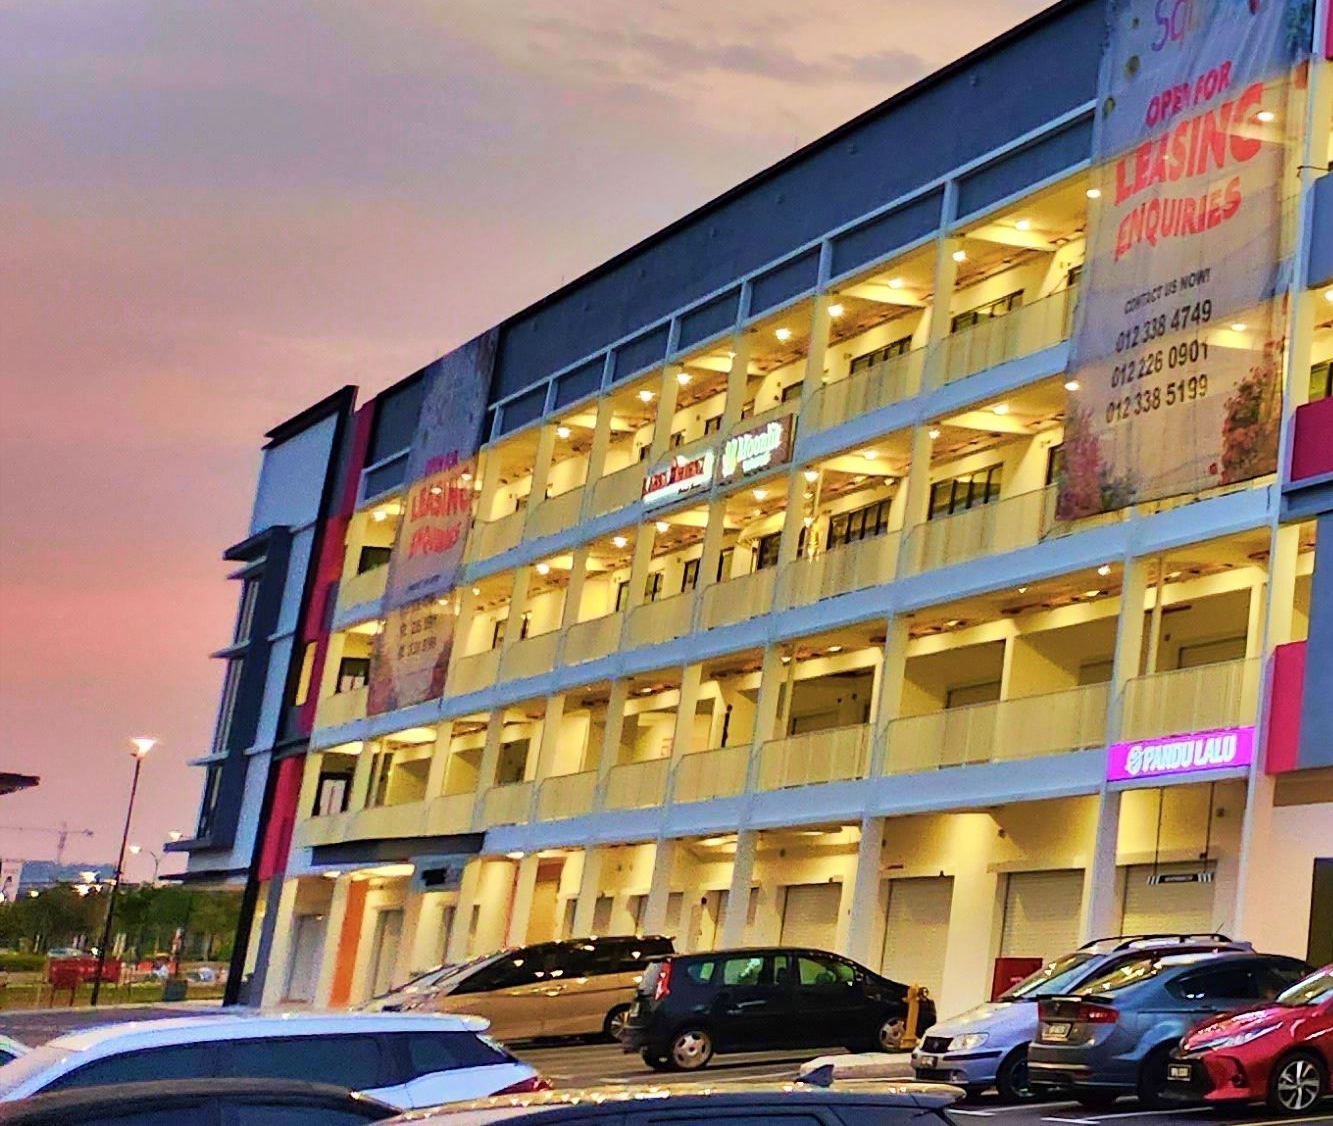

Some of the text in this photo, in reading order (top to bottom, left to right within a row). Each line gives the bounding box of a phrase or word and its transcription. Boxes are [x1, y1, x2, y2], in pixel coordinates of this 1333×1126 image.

[1193, 60, 1233, 105] FOR
[1114, 82, 1265, 207] LEASING
[1114, 176, 1243, 263] ENQUIRIES
[1170, 299, 1213, 332] 4749
[1166, 373, 1208, 406] 5199
[1142, 734, 1237, 772] PANDU LALU
